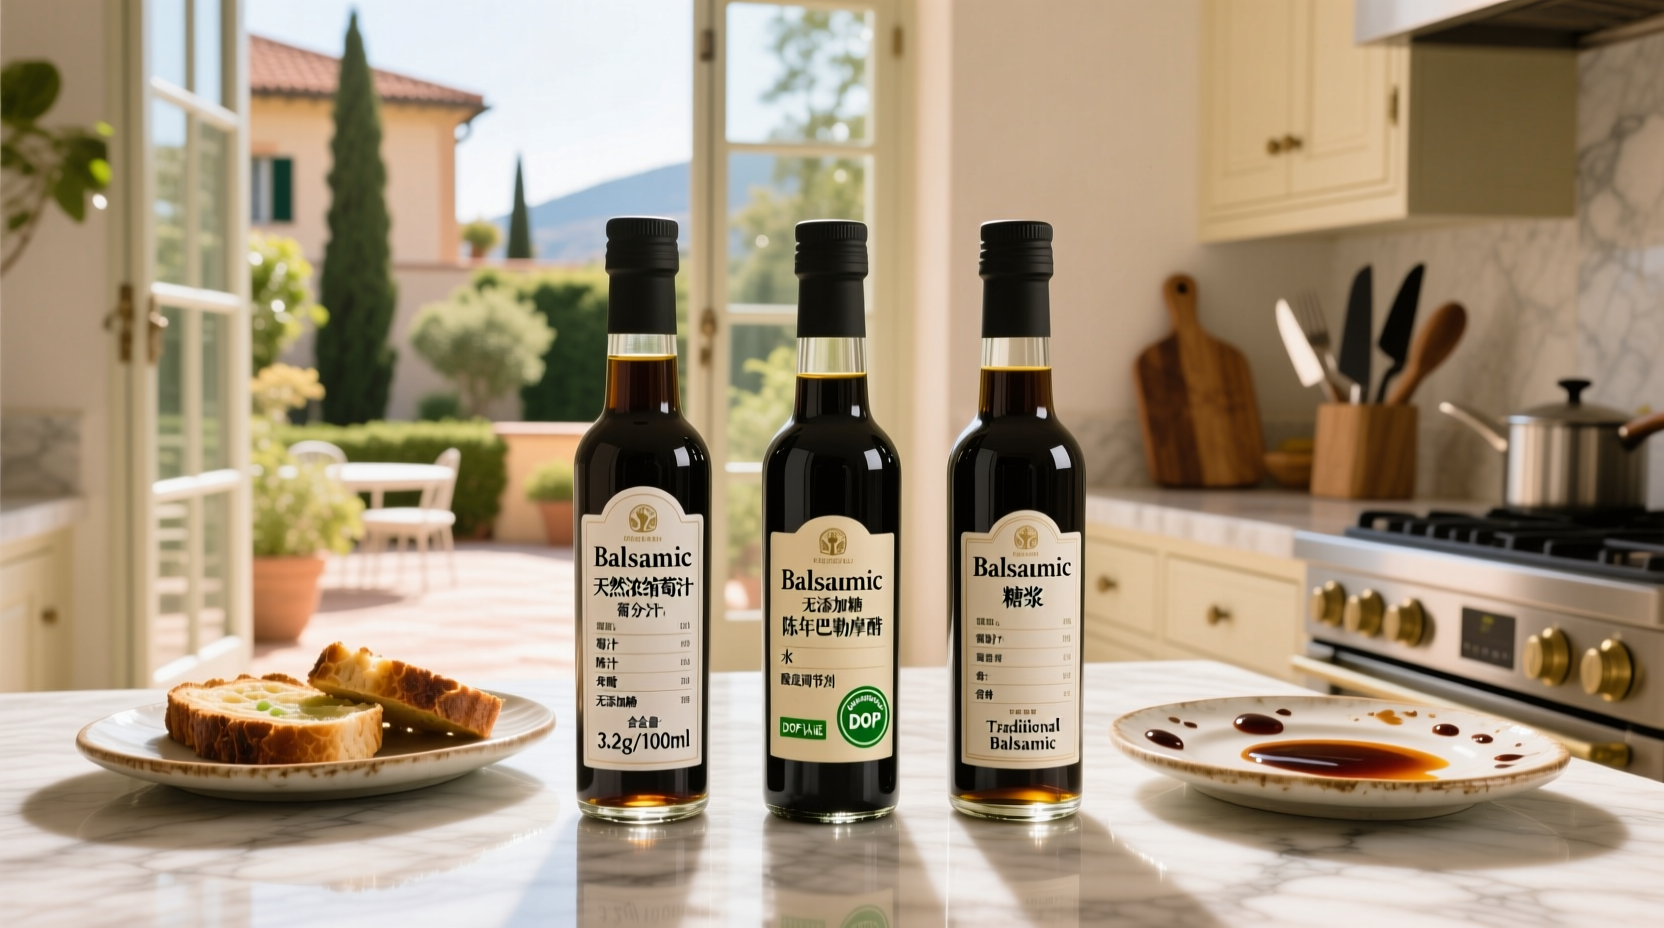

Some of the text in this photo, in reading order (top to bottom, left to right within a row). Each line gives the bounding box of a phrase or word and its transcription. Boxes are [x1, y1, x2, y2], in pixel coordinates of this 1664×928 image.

[593, 546, 692, 568] Balsamic
[1002, 585, 1044, 609] 糖浆
[781, 648, 793, 665] 水
[849, 712, 881, 730] DOP
[597, 729, 690, 755] 3.2g/100ml
[990, 735, 1056, 751] Balsamic
